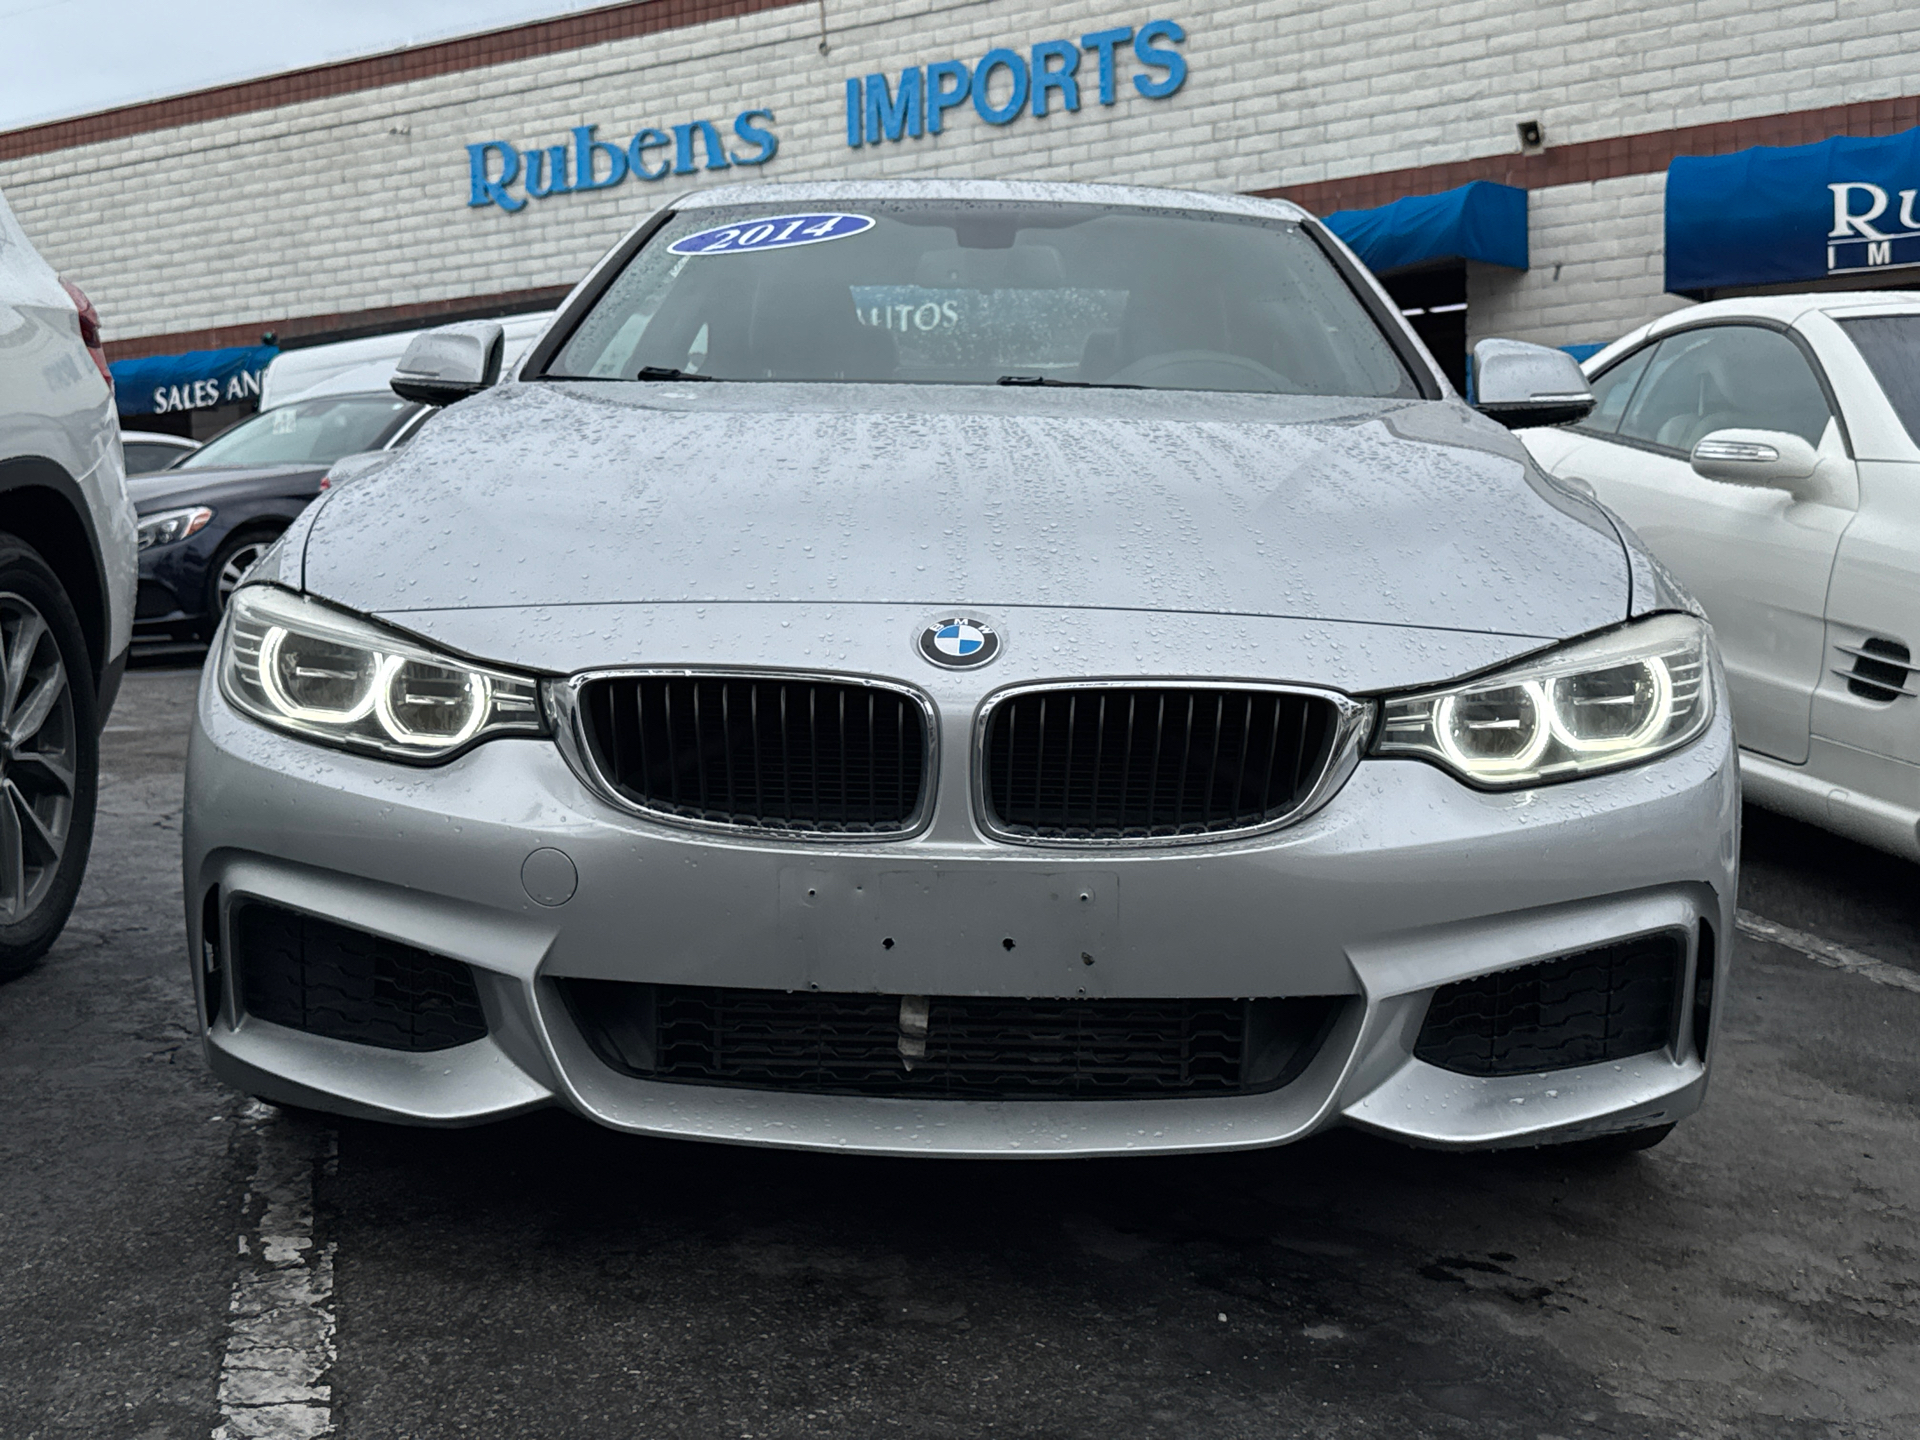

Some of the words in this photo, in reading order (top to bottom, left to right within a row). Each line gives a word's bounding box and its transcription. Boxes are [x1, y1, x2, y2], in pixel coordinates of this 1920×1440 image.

[466, 108, 778, 212] Rubens
[846, 19, 1189, 148] IMPORTS
[701, 216, 843, 252] 2014
[856, 300, 958, 332] UTOS
[154, 378, 219, 414] SALES
[225, 368, 269, 400] AN
[929, 618, 994, 634] BMW
